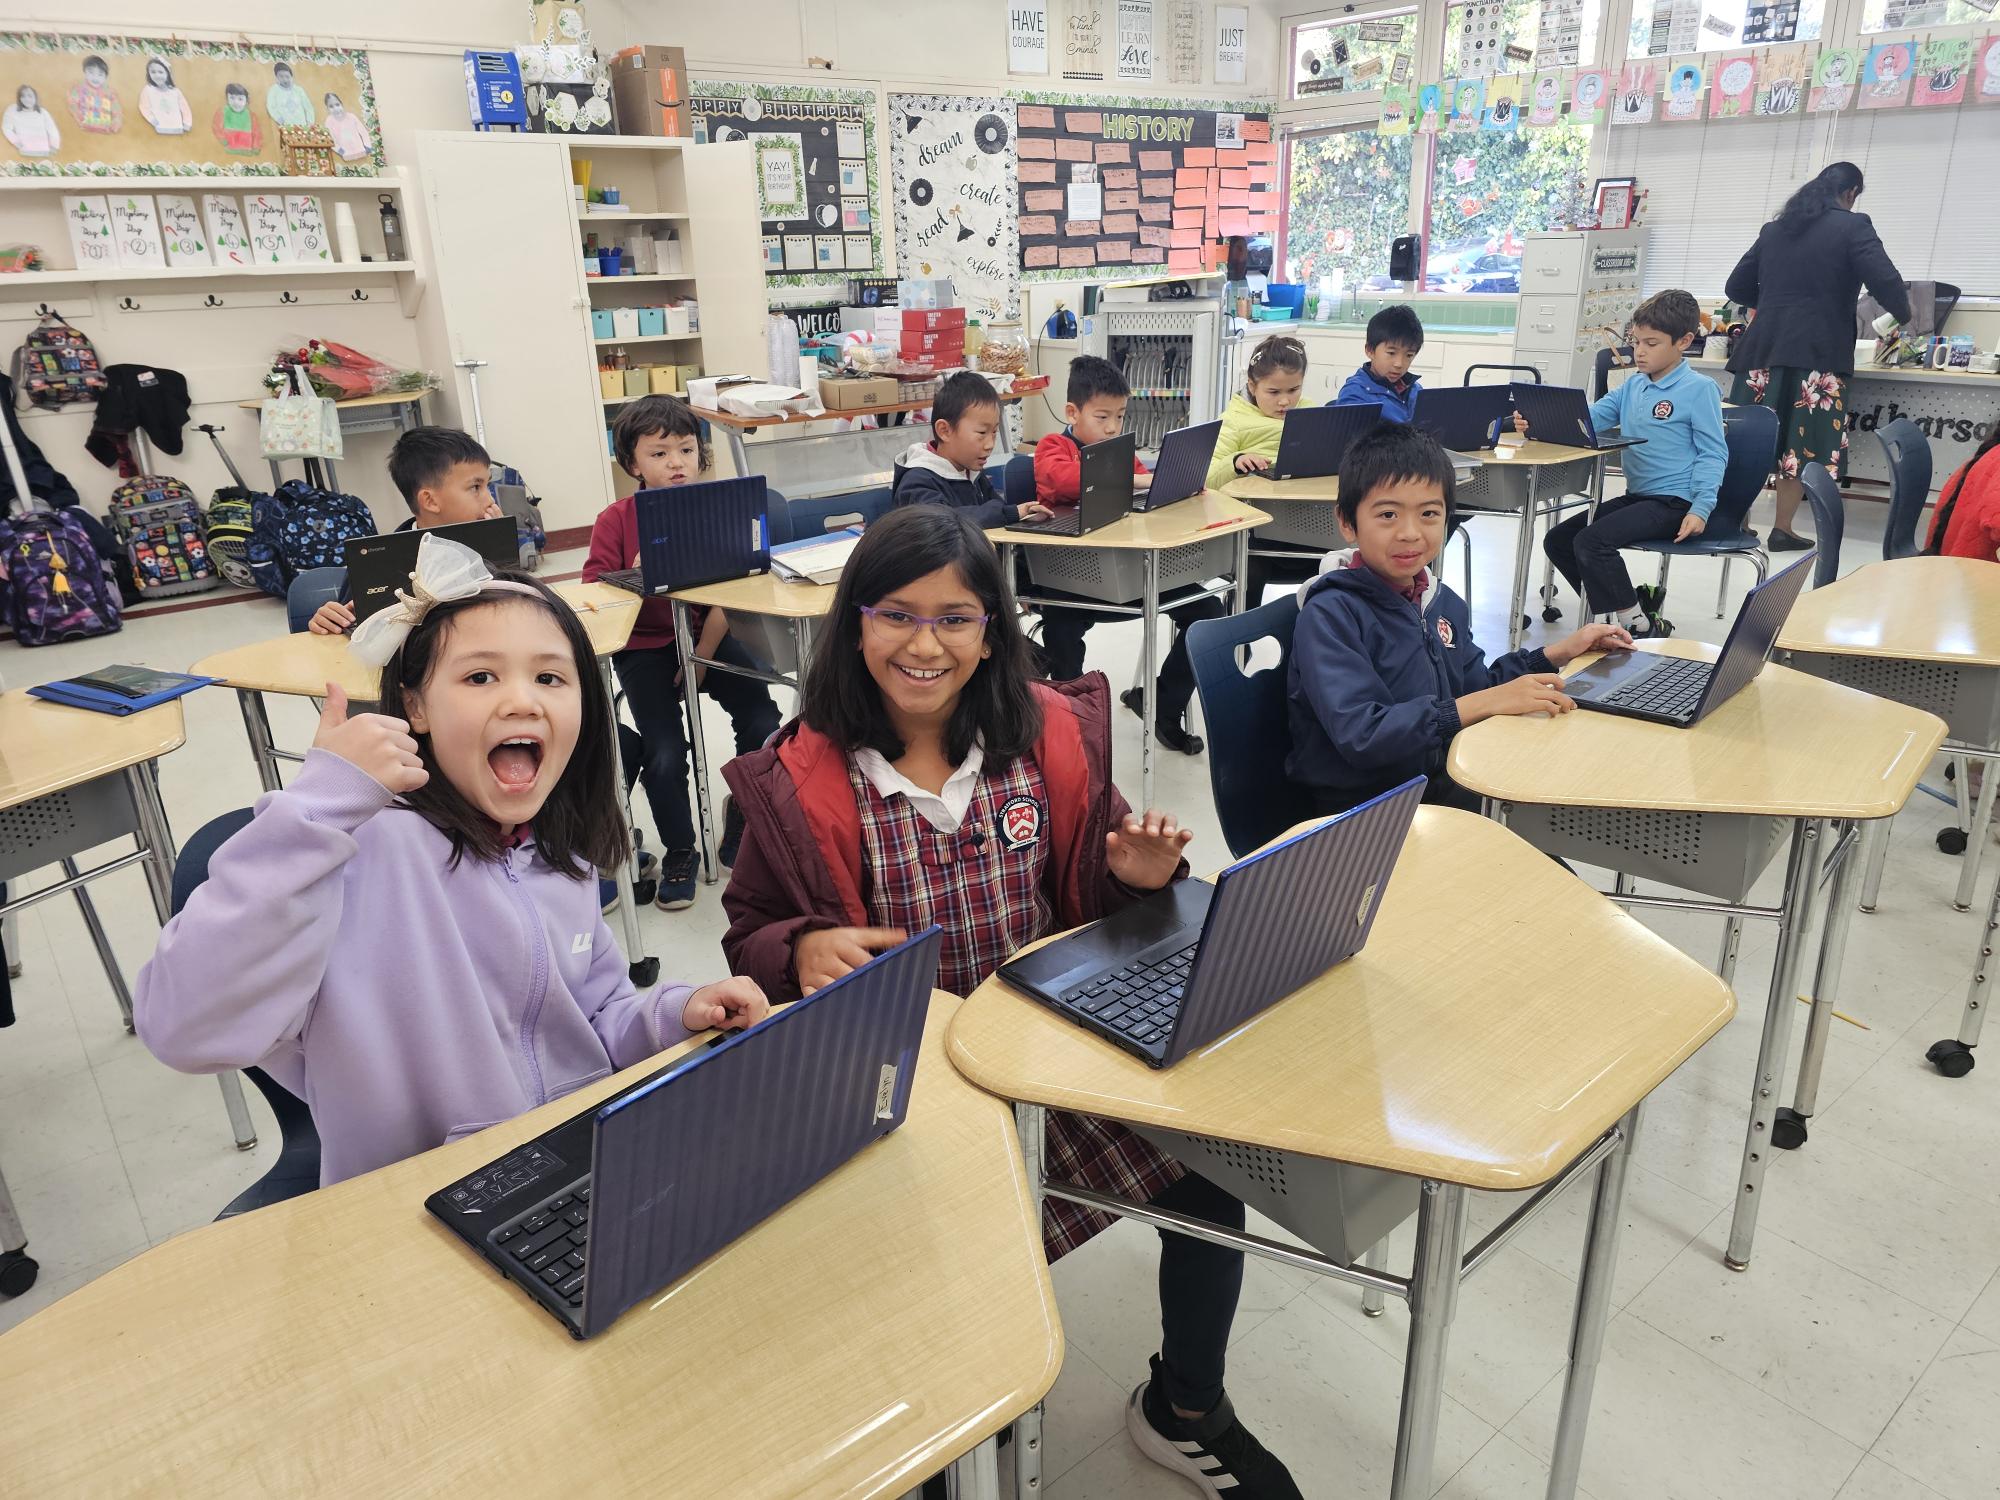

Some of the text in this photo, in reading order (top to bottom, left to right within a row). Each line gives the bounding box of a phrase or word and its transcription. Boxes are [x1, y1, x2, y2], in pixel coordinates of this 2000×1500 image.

[1012, 10, 1045, 33] HAVE
[1012, 36, 1045, 49] COURAGE
[1121, 32, 1150, 45] LEARN
[1219, 28, 1245, 47] JUST
[1219, 51, 1244, 63] BREATHE
[690, 101, 860, 116] APPY BIRTHDAY
[1102, 113, 1195, 142] HISTORY
[919, 131, 964, 167] dream
[766, 161, 791, 172] YAY!
[778, 173, 792, 182] YOUR
[959, 183, 1003, 206] create
[916, 207, 949, 248] read
[966, 255, 1005, 281] explore
[797, 312, 840, 336] WELCO
[366, 585, 389, 595] acer
[1022, 796, 1040, 808] SCHOOL
[878, 1076, 892, 1113] Evelyn
